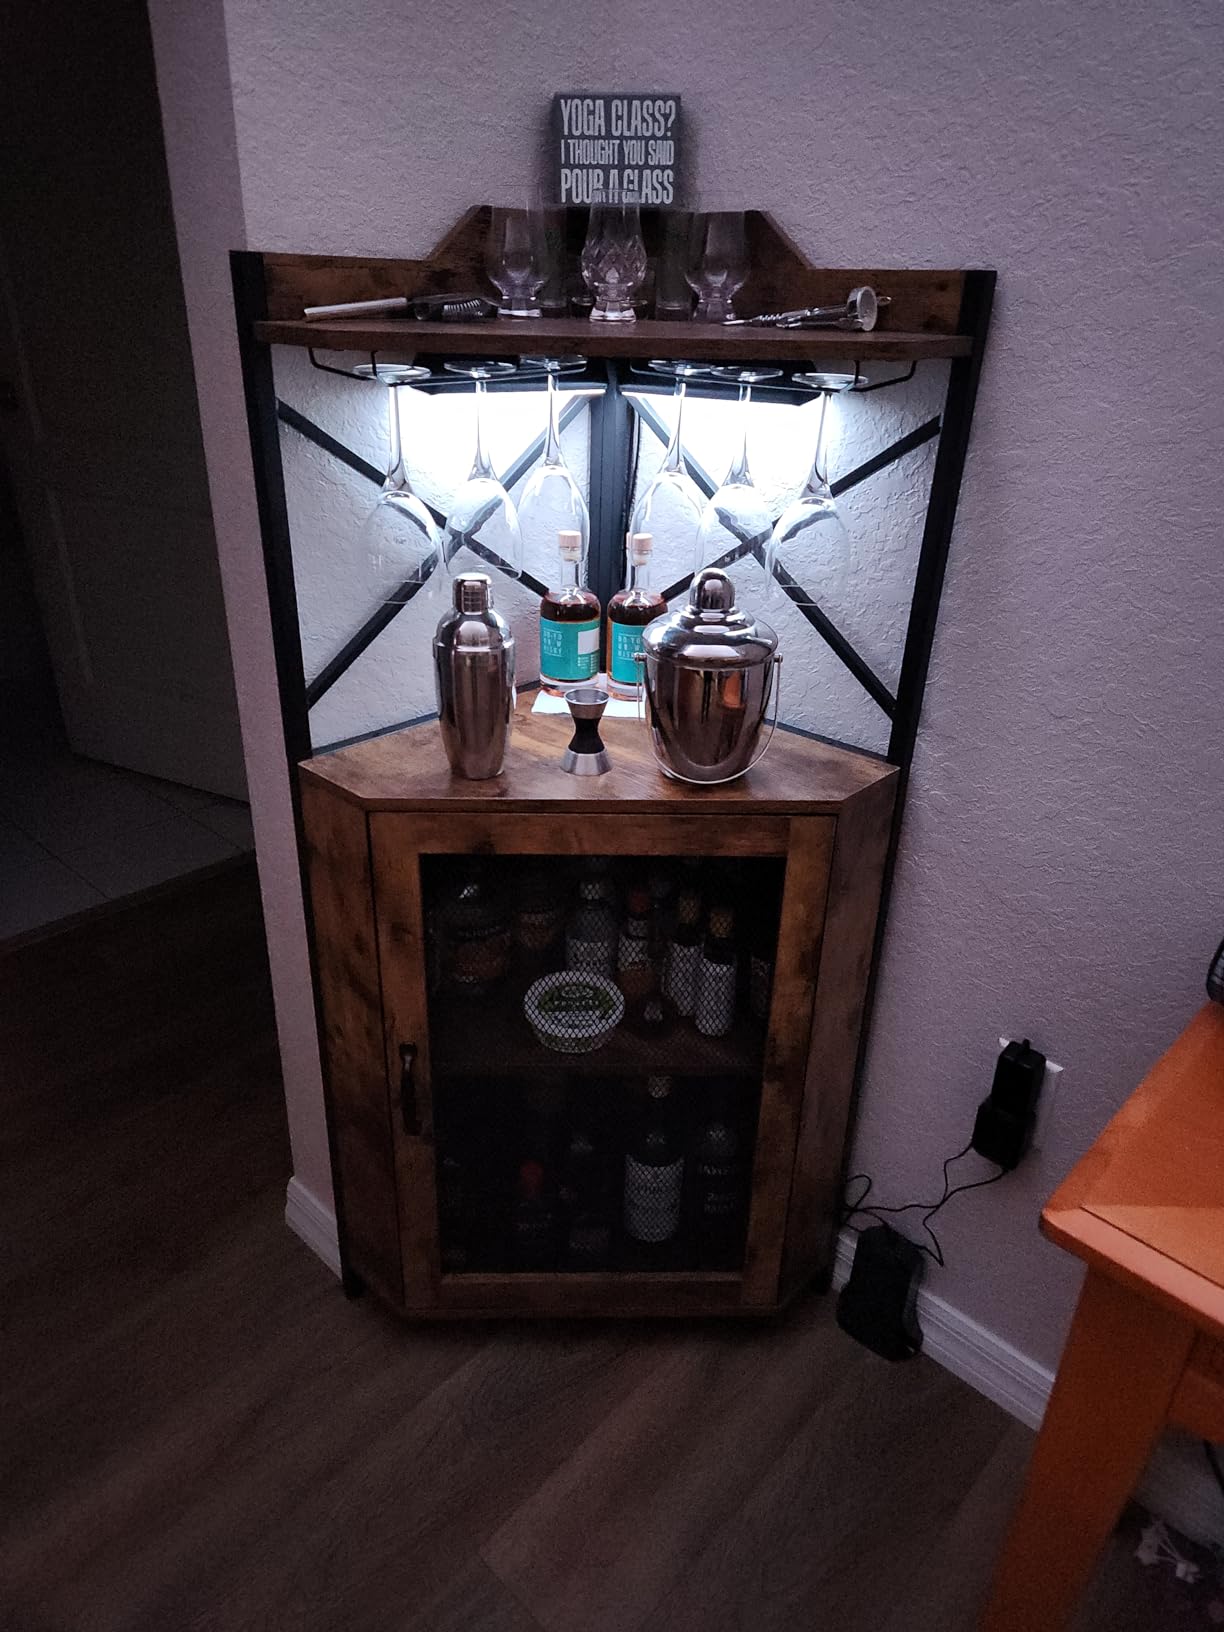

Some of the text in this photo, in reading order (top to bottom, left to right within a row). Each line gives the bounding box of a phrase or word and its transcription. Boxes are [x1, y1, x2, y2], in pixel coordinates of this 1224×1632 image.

[560, 98, 676, 137] YOGA CLASS?
[561, 139, 675, 166] I THOUGHT YOU SAID
[561, 168, 673, 204] POUR A GLASS
